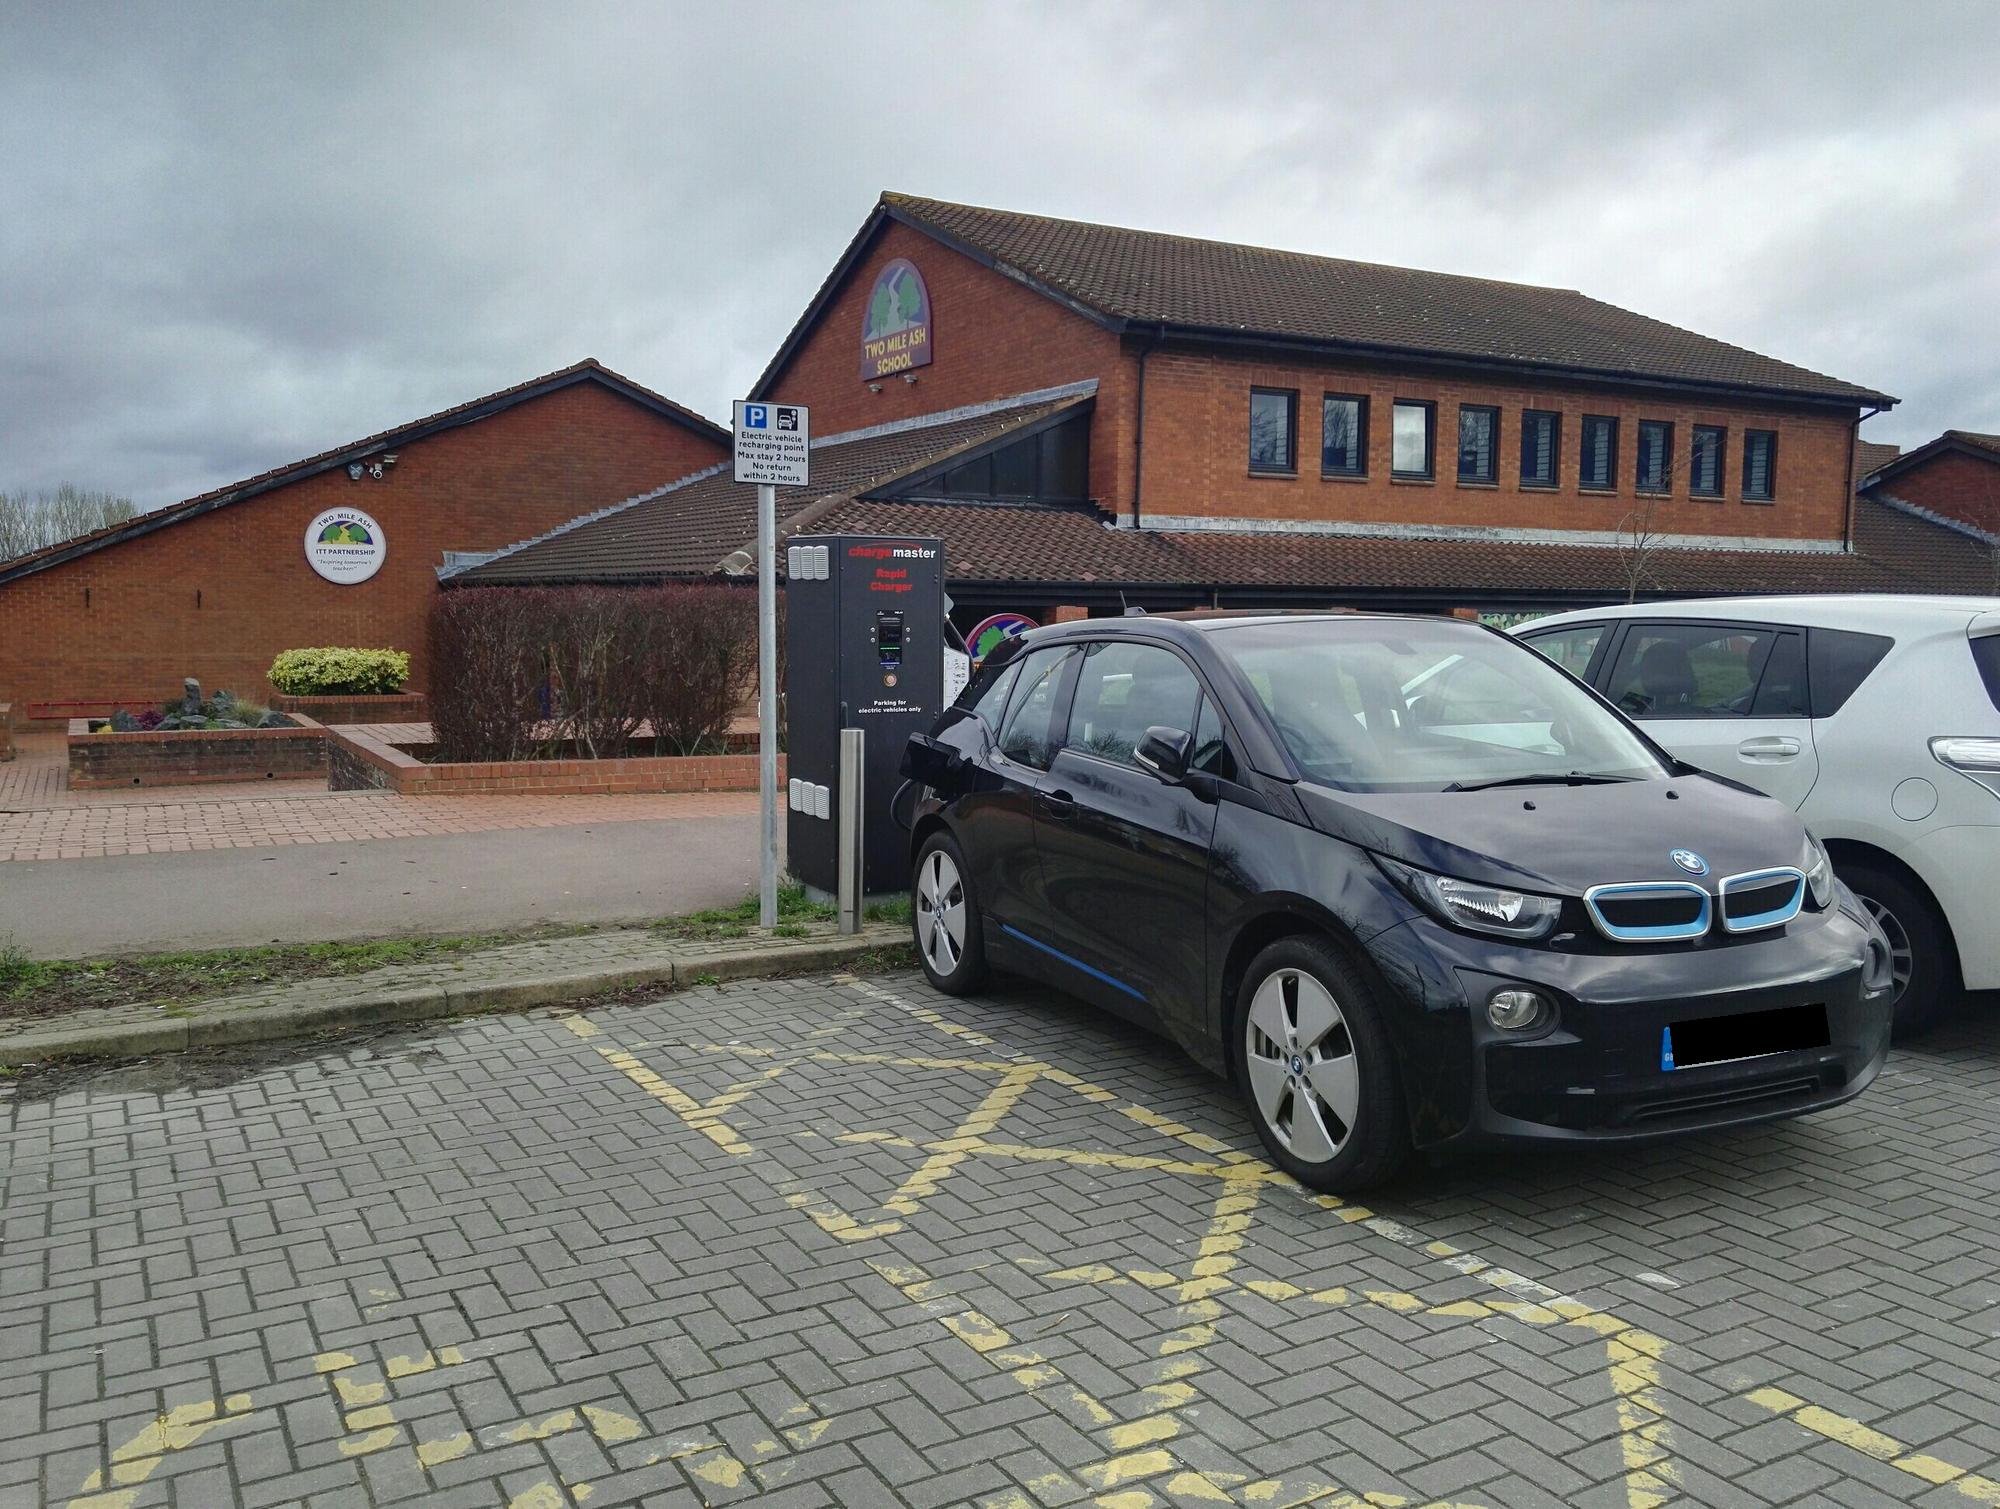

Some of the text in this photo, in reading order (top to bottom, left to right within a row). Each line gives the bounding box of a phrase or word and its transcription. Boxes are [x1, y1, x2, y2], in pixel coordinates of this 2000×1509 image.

[865, 327, 926, 359] TWO MILE ASH
[876, 351, 912, 375] SCHOOL
[750, 407, 764, 426] P
[741, 431, 802, 443] Electric vehicle
[739, 441, 804, 452] recharging point
[738, 451, 806, 463] Max stay 2 hours
[752, 462, 791, 472] No return
[743, 472, 800, 482] within 2 hours
[318, 515, 334, 527] TWO
[358, 517, 372, 529] ASH
[848, 547, 936, 559] chargemaster
[876, 568, 907, 579] Rapid
[870, 582, 913, 592] Charger
